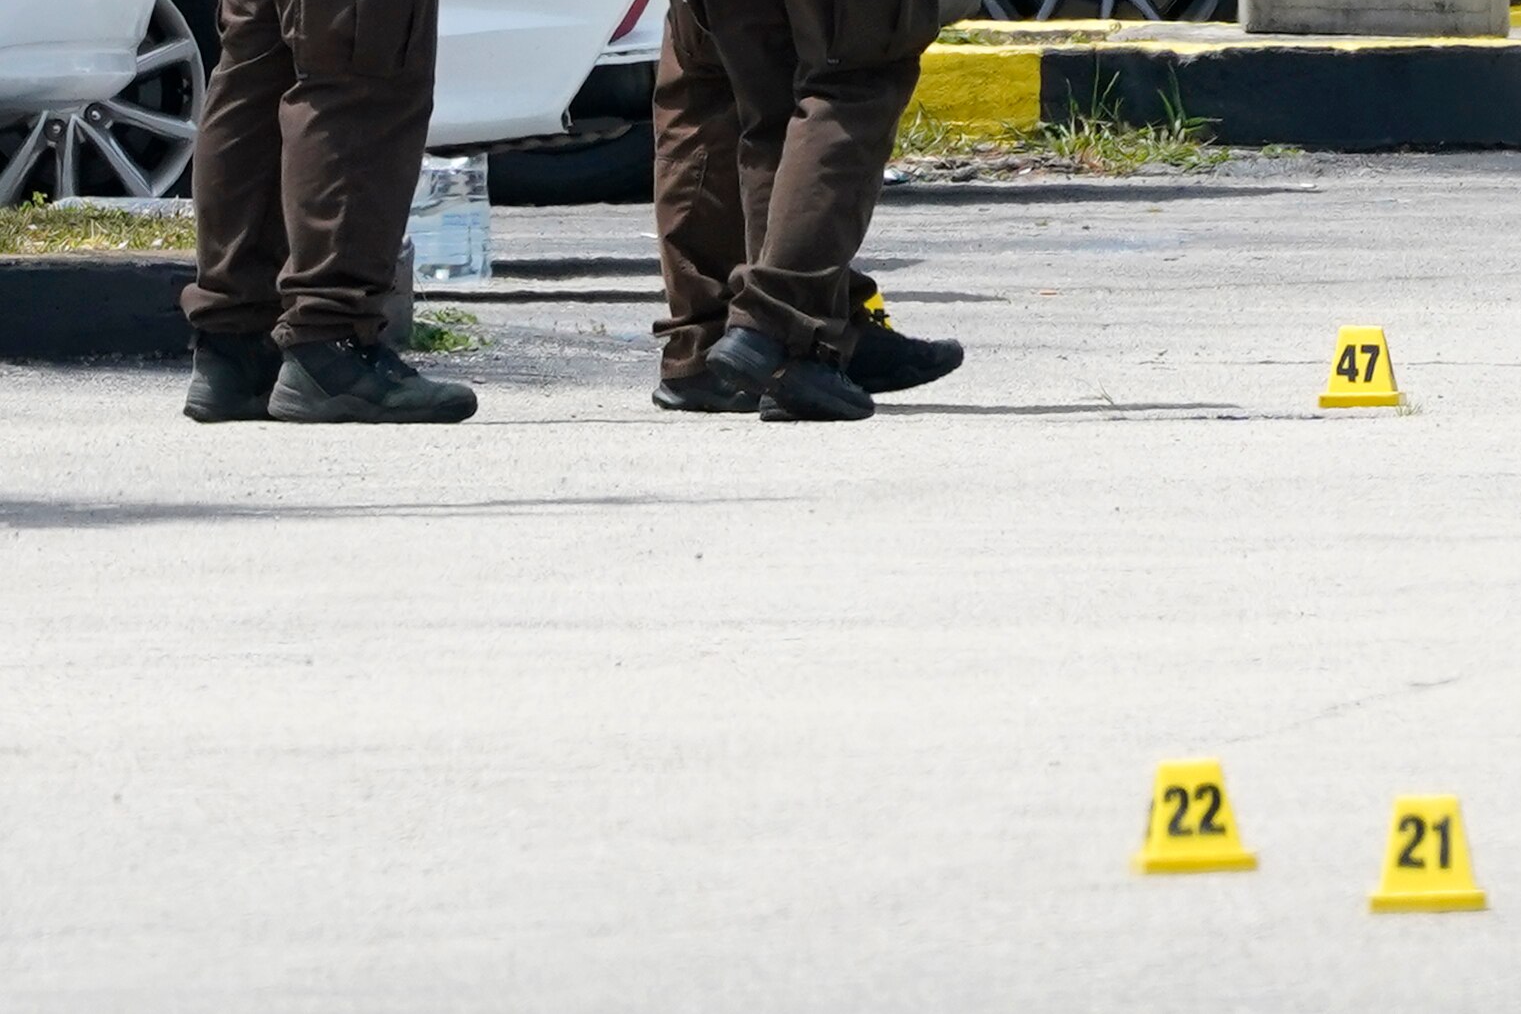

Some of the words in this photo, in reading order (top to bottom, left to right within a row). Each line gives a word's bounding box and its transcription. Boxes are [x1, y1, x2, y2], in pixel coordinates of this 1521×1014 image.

[1336, 344, 1380, 383] 47
[1164, 783, 1226, 837] 22
[1397, 814, 1451, 870] 21
